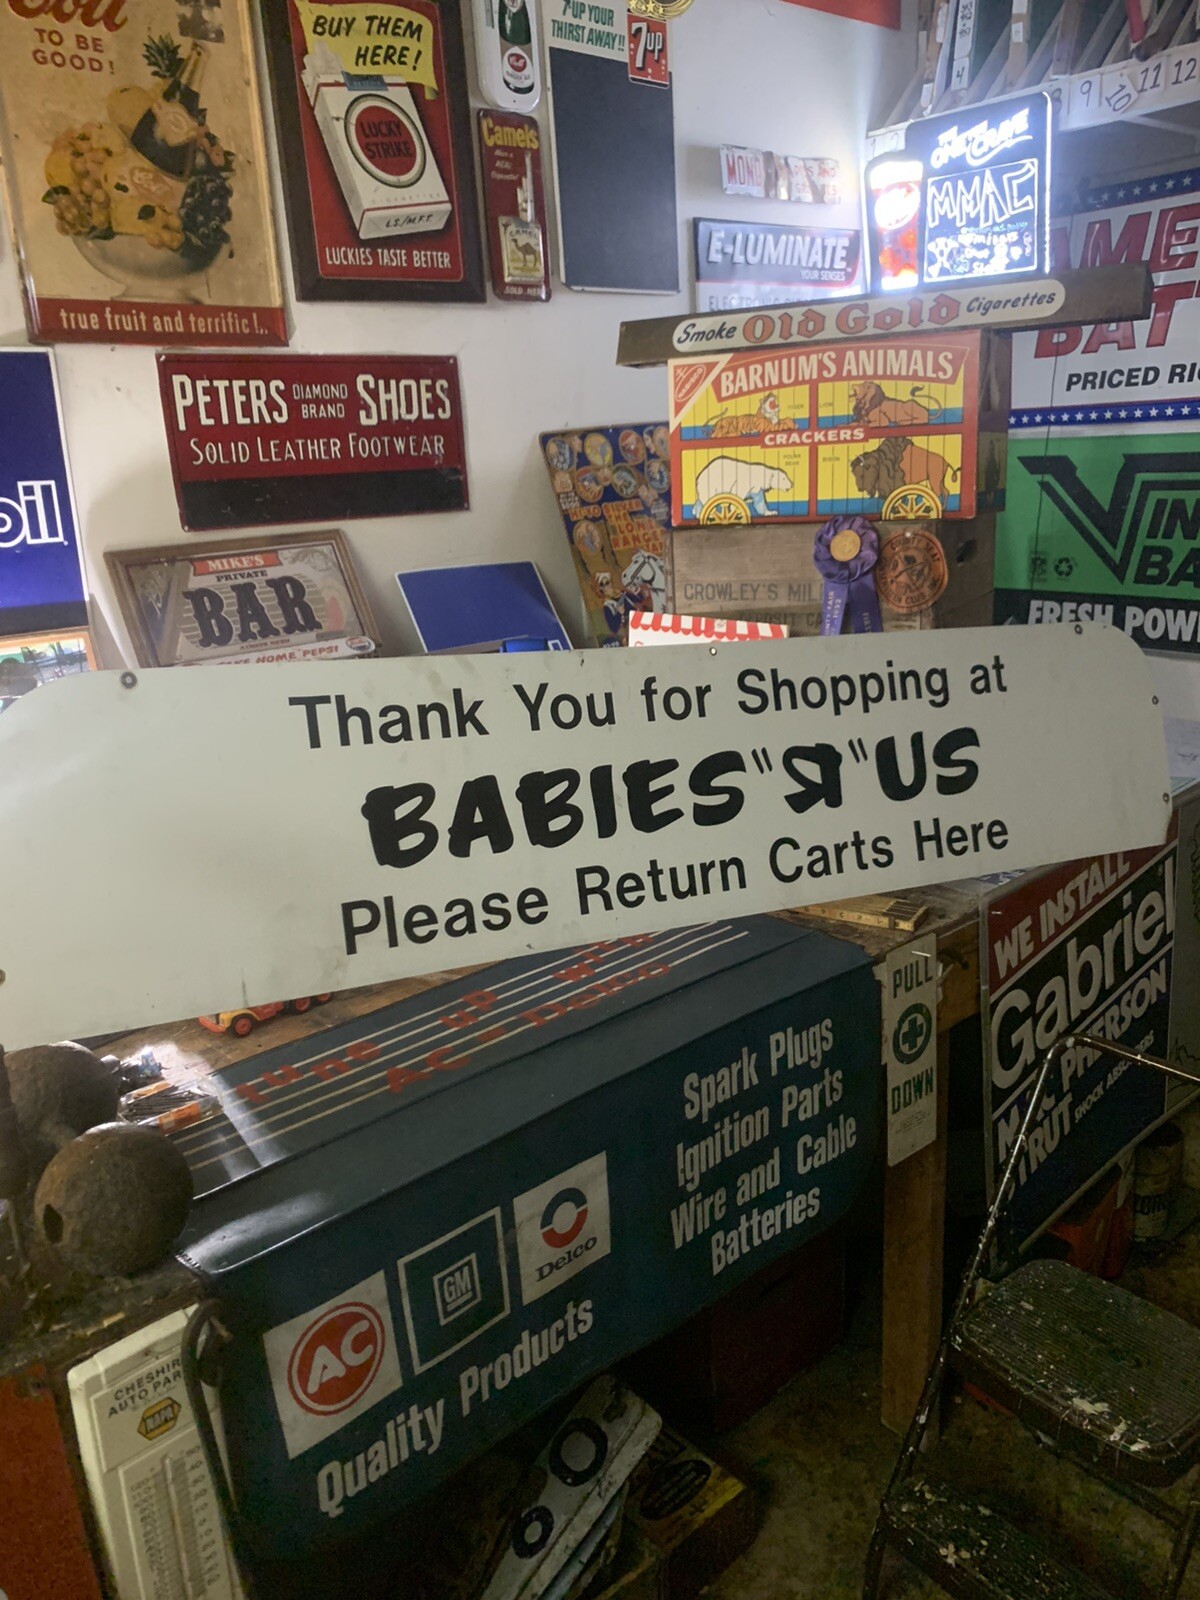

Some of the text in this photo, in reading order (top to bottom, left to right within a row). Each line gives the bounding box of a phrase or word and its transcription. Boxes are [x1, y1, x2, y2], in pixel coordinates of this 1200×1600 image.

[313, 15, 422, 41] BUY THEM
[551, 19, 585, 43] THIRST
[588, 4, 614, 26] YOUR
[34, 27, 104, 53] TO BE
[32, 49, 114, 74] GOOD!
[355, 46, 422, 71] HERE!
[955, 65, 965, 86] 4
[1080, 80, 1092, 107] 9
[1137, 62, 1162, 93] 11
[1171, 57, 1197, 85] 12
[360, 120, 402, 139] LUCKY
[483, 116, 540, 149] Camels
[365, 141, 413, 160] STRIKE
[326, 247, 452, 269] LUCKIES TASTE BETTER
[707, 230, 850, 269] E-LUMINATE
[800, 270, 846, 281] YOUR SENSES
[60, 308, 99, 330] true
[105, 307, 147, 332] fruit
[152, 309, 183, 333] and
[677, 290, 1057, 347] Smoke Old Gold Cigarettes
[720, 348, 954, 398] BARNUM'S ANIMALS
[1066, 365, 1161, 392] PRICED
[172, 373, 451, 431] PETERS SHOES
[292, 383, 348, 400] DIAMOND
[301, 403, 345, 419] BRAND
[190, 432, 445, 466] SOLID LEATHER FOOTWEAR
[764, 427, 866, 447] CRACKERS
[617, 519, 659, 535] LONE
[207, 554, 264, 572] MIKE'S
[216, 569, 268, 582] PRIVATE
[684, 582, 779, 602] CROWLEY'S
[182, 575, 323, 648] BAR
[1028, 600, 1200, 644] FRESH POW
[255, 651, 296, 664] HOME
[303, 644, 339, 658] PEPSI
[289, 655, 1008, 750] Thank You for Shopping at
[342, 818, 1010, 956] Please Return Carts Here
[993, 850, 1131, 979] WE INSTALL
[893, 956, 933, 999] PULL
[990, 856, 1175, 1090] Gabriel
[385, 962, 673, 1094] AC Delco
[683, 1017, 834, 1124] Spark Plugs
[891, 1066, 934, 1115] DOWN
[1074, 1080, 1105, 1124] SHOCK
[676, 1067, 843, 1193] Ignition Parts
[670, 1186, 727, 1250] Wire
[736, 1146, 781, 1207] and
[796, 1114, 857, 1175] Cable
[710, 1187, 821, 1277] Batteries
[535, 1236, 598, 1283] Delco
[442, 1267, 473, 1303] GM
[306, 1318, 374, 1395] AC
[459, 1299, 595, 1417] Products
[107, 1389, 151, 1419] AUTO
[316, 1398, 445, 1519] Quality
